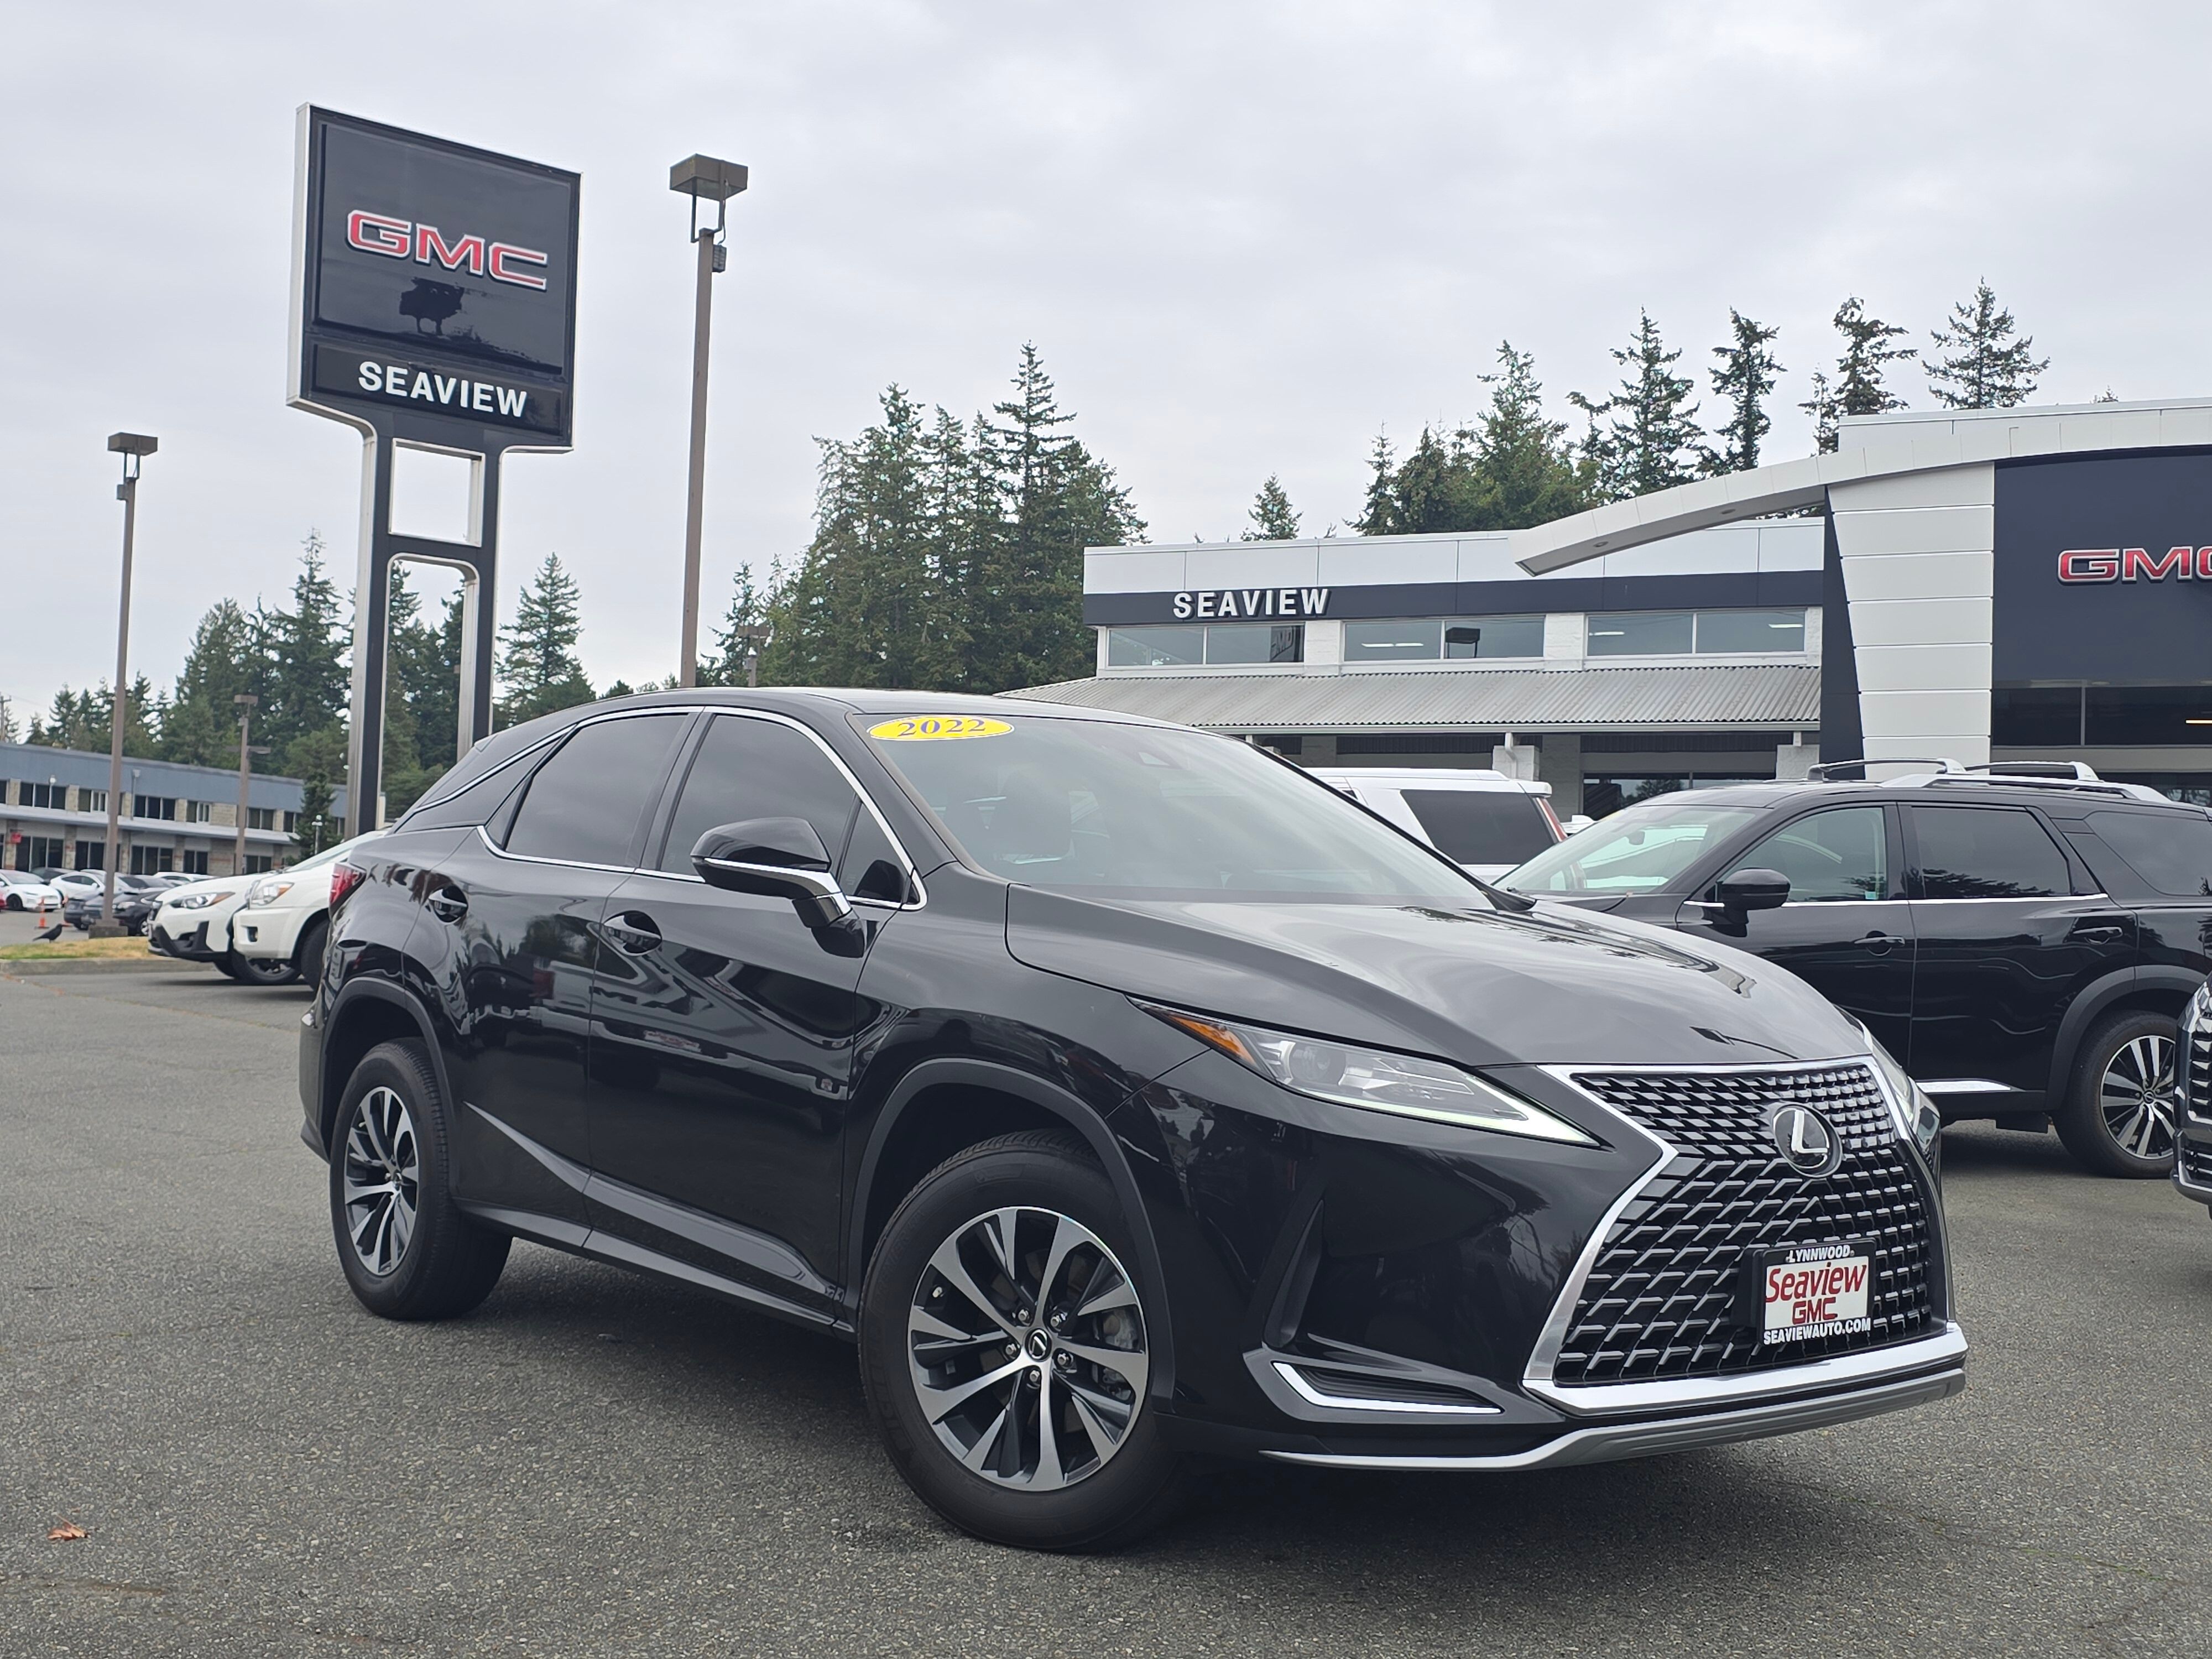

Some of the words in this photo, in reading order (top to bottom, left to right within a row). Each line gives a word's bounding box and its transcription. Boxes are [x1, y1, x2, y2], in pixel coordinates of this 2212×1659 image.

[348, 210, 547, 290] GMC
[358, 361, 527, 418] SEAVIEW
[2058, 546, 2212, 582] GM
[1173, 588, 1328, 619] SEAVIEW
[897, 719, 986, 737] 2022
[1787, 1244, 1851, 1263] LYNNWOOD
[1765, 1261, 1867, 1303] Seaview
[1792, 1297, 1838, 1325] GMC
[1764, 1318, 1871, 1345] SEAVIEWAUTO.COM
